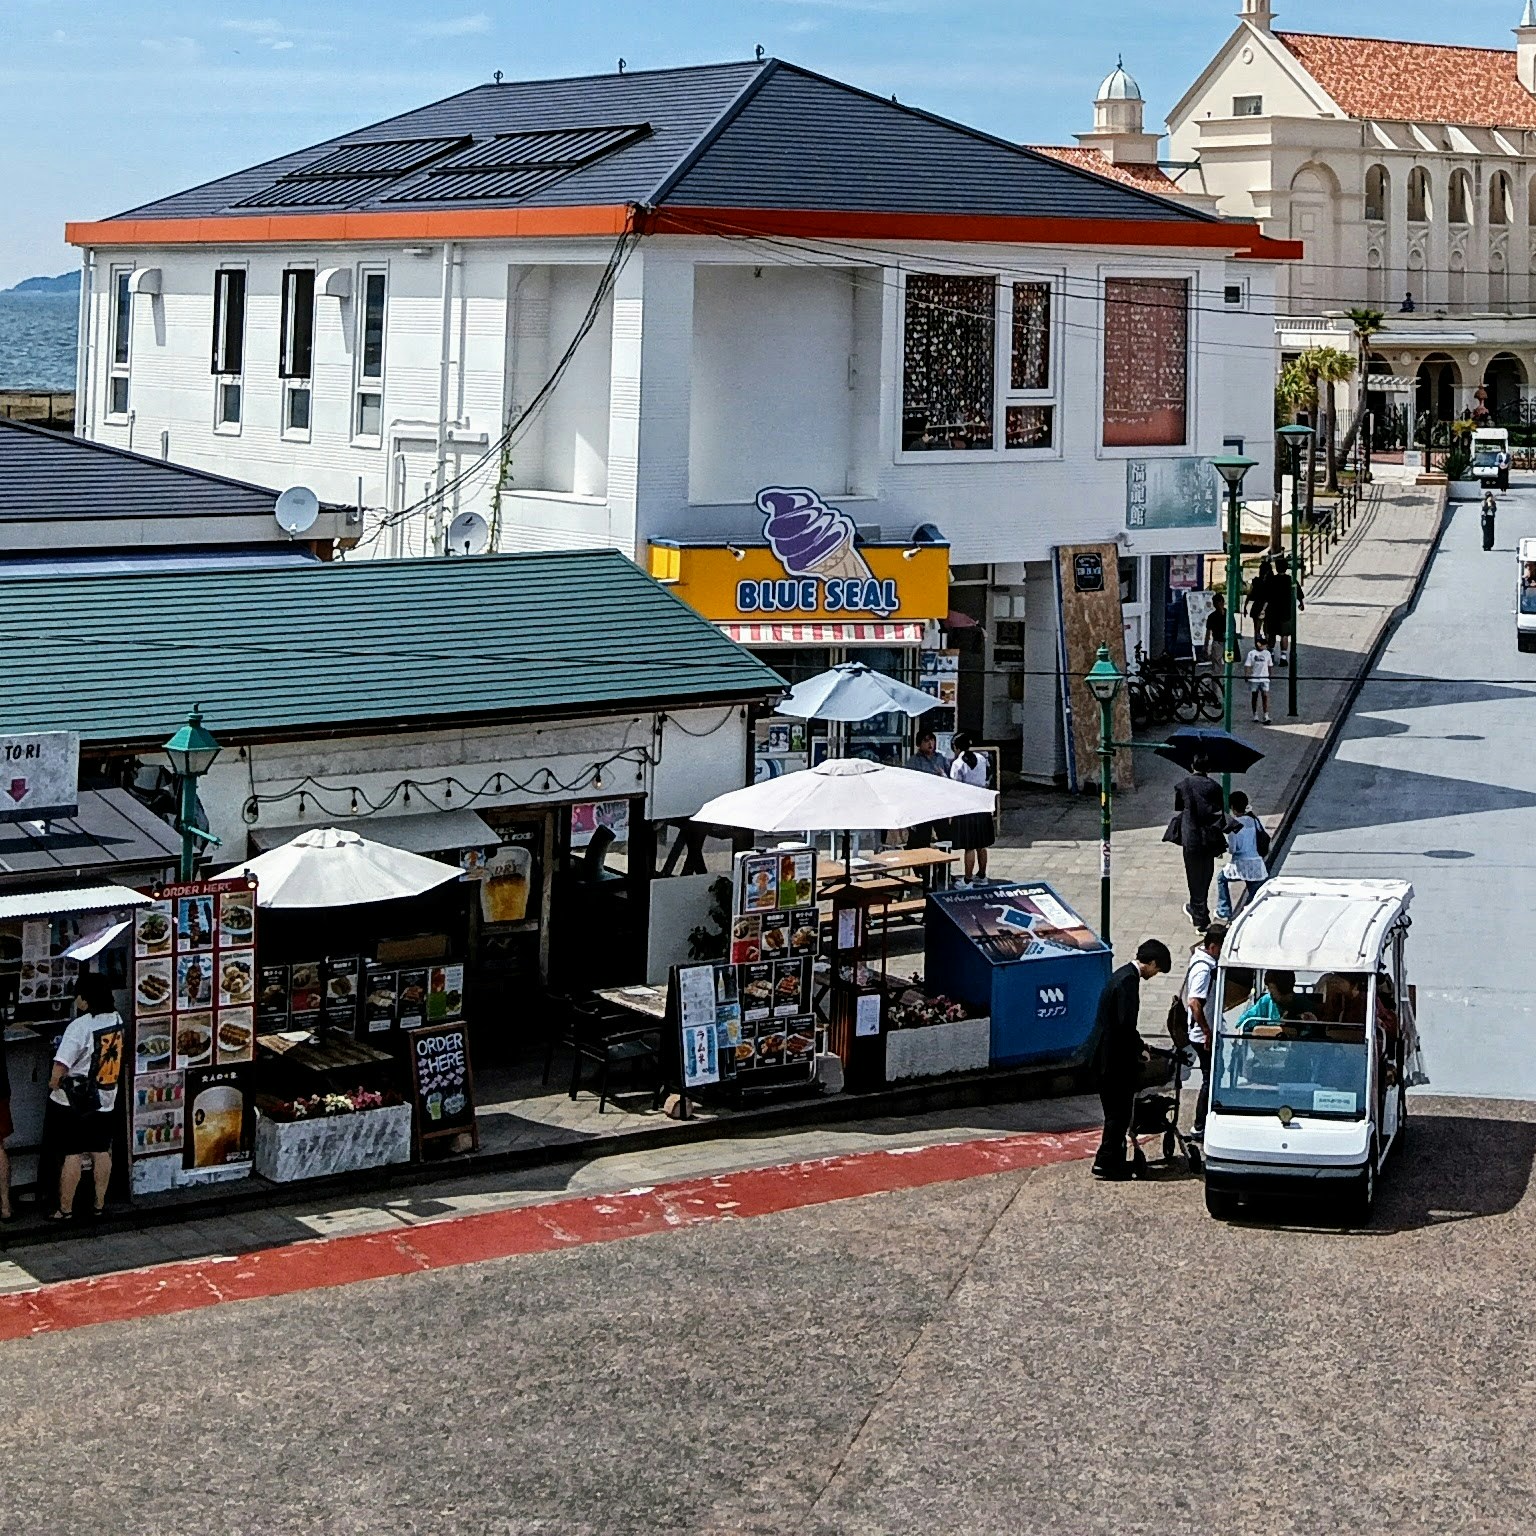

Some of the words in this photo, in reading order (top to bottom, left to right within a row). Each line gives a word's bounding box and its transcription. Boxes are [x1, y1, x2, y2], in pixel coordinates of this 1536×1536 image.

[737, 579, 819, 611] BLUE
[824, 578, 899, 611] SEAL
[162, 885, 200, 898] ORDER
[993, 887, 1046, 898] Marizon
[416, 1032, 463, 1056] ORDER
[427, 1050, 465, 1074] HERE
